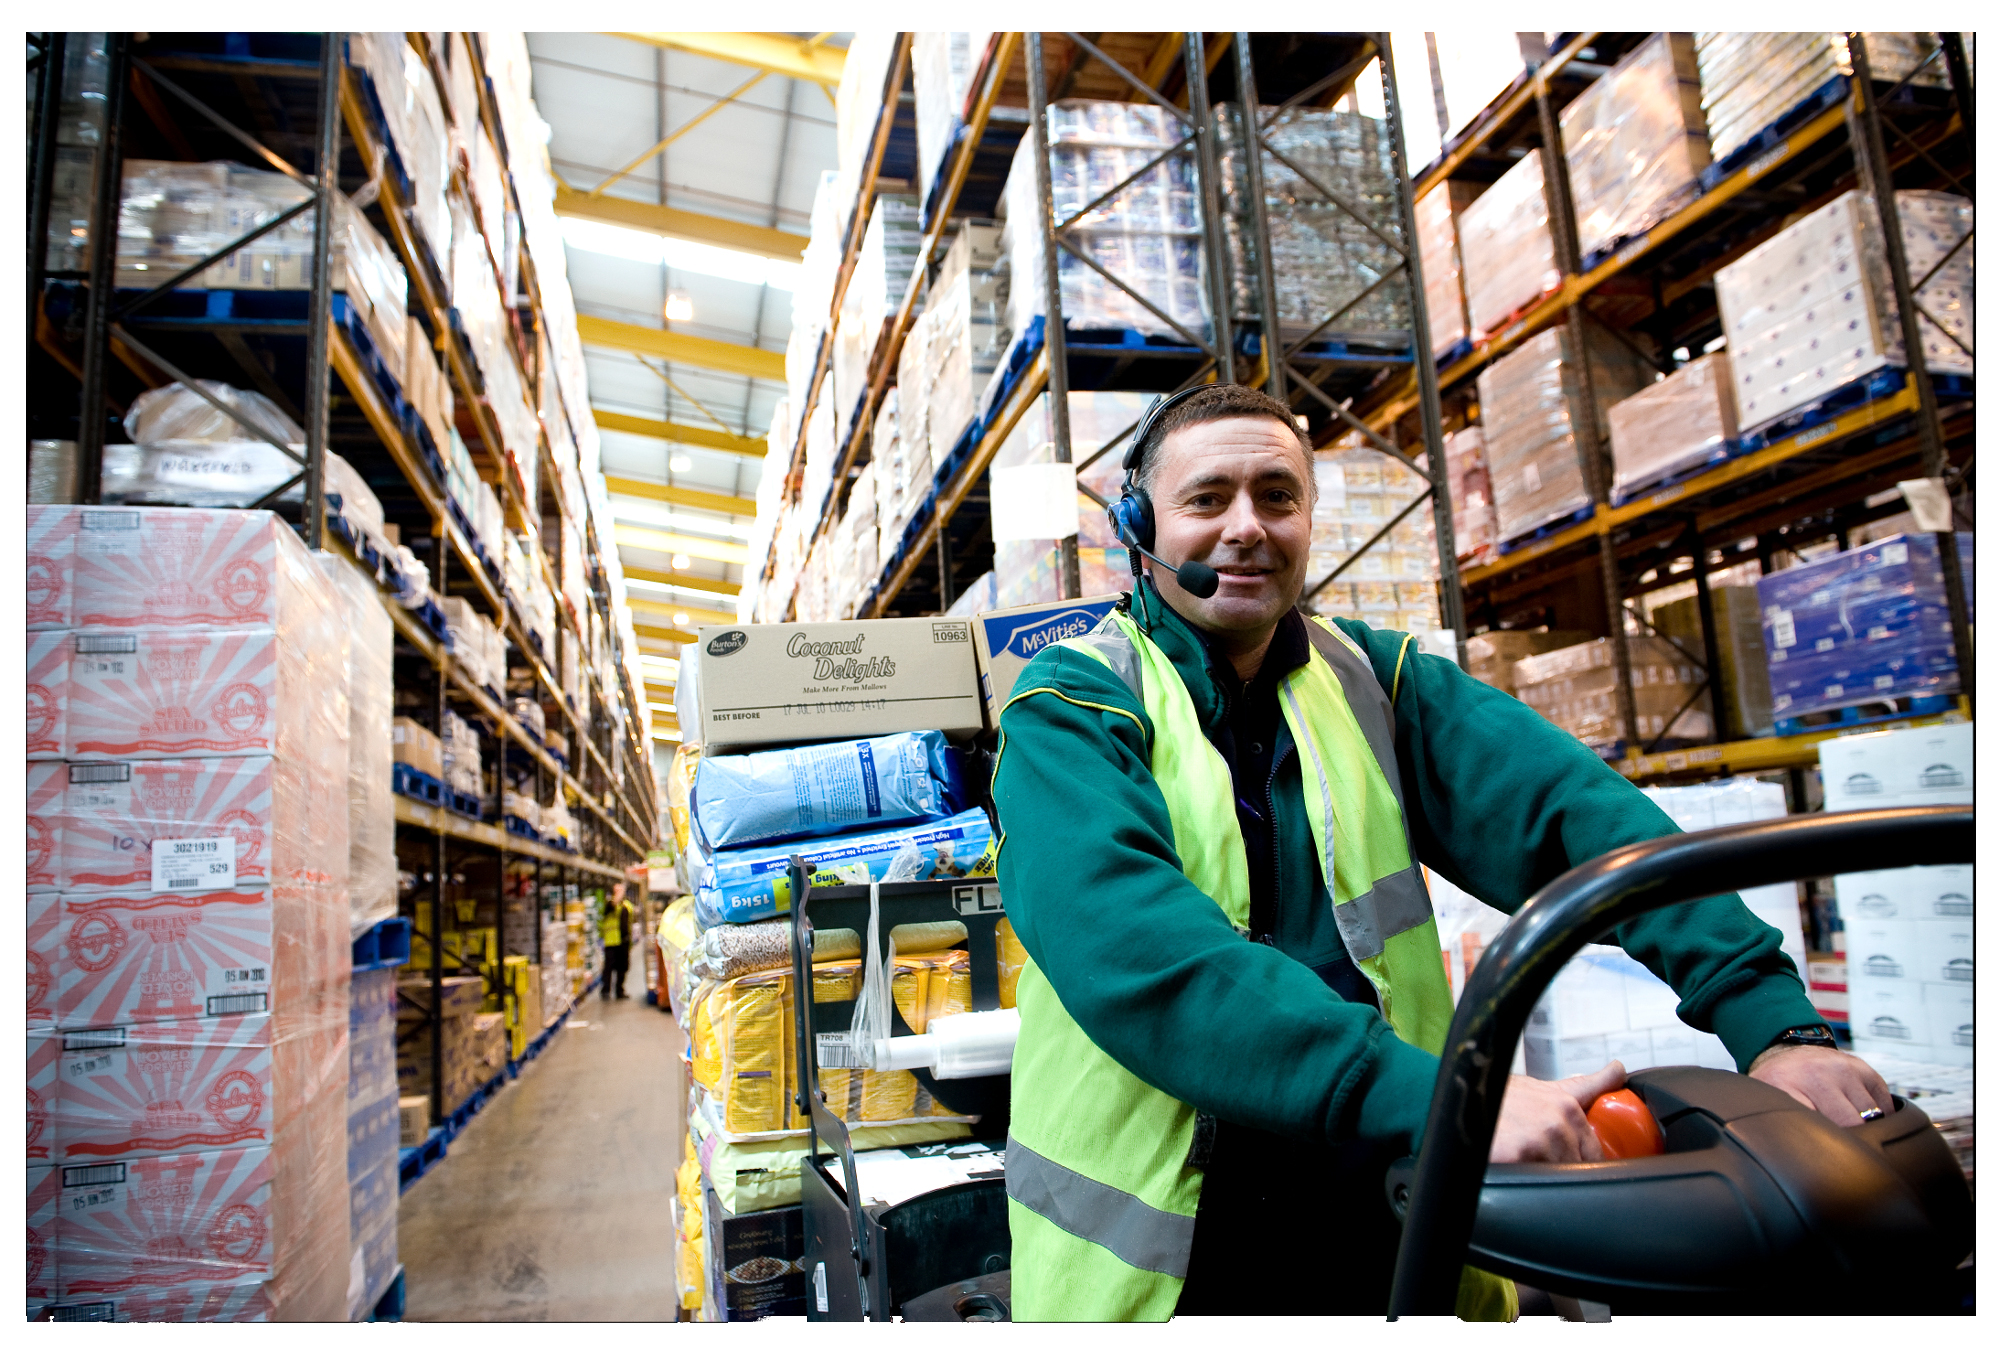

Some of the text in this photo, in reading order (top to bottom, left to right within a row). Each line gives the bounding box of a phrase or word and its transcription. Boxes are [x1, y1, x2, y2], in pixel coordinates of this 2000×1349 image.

[935, 631, 966, 641] 10963
[1022, 617, 1088, 654] McVitie's
[711, 639, 742, 648] Burton's
[787, 632, 865, 659] Coconut
[813, 655, 896, 683] Delights
[732, 712, 760, 720] BEFORE
[174, 842, 217, 853] 3021919
[862, 844, 887, 853] Enriched
[823, 850, 845, 859] artificial
[209, 863, 228, 874] 529
[731, 893, 770, 908] 15kg
[954, 886, 1004, 912] FL
[73, 1196, 86, 1210] 05
